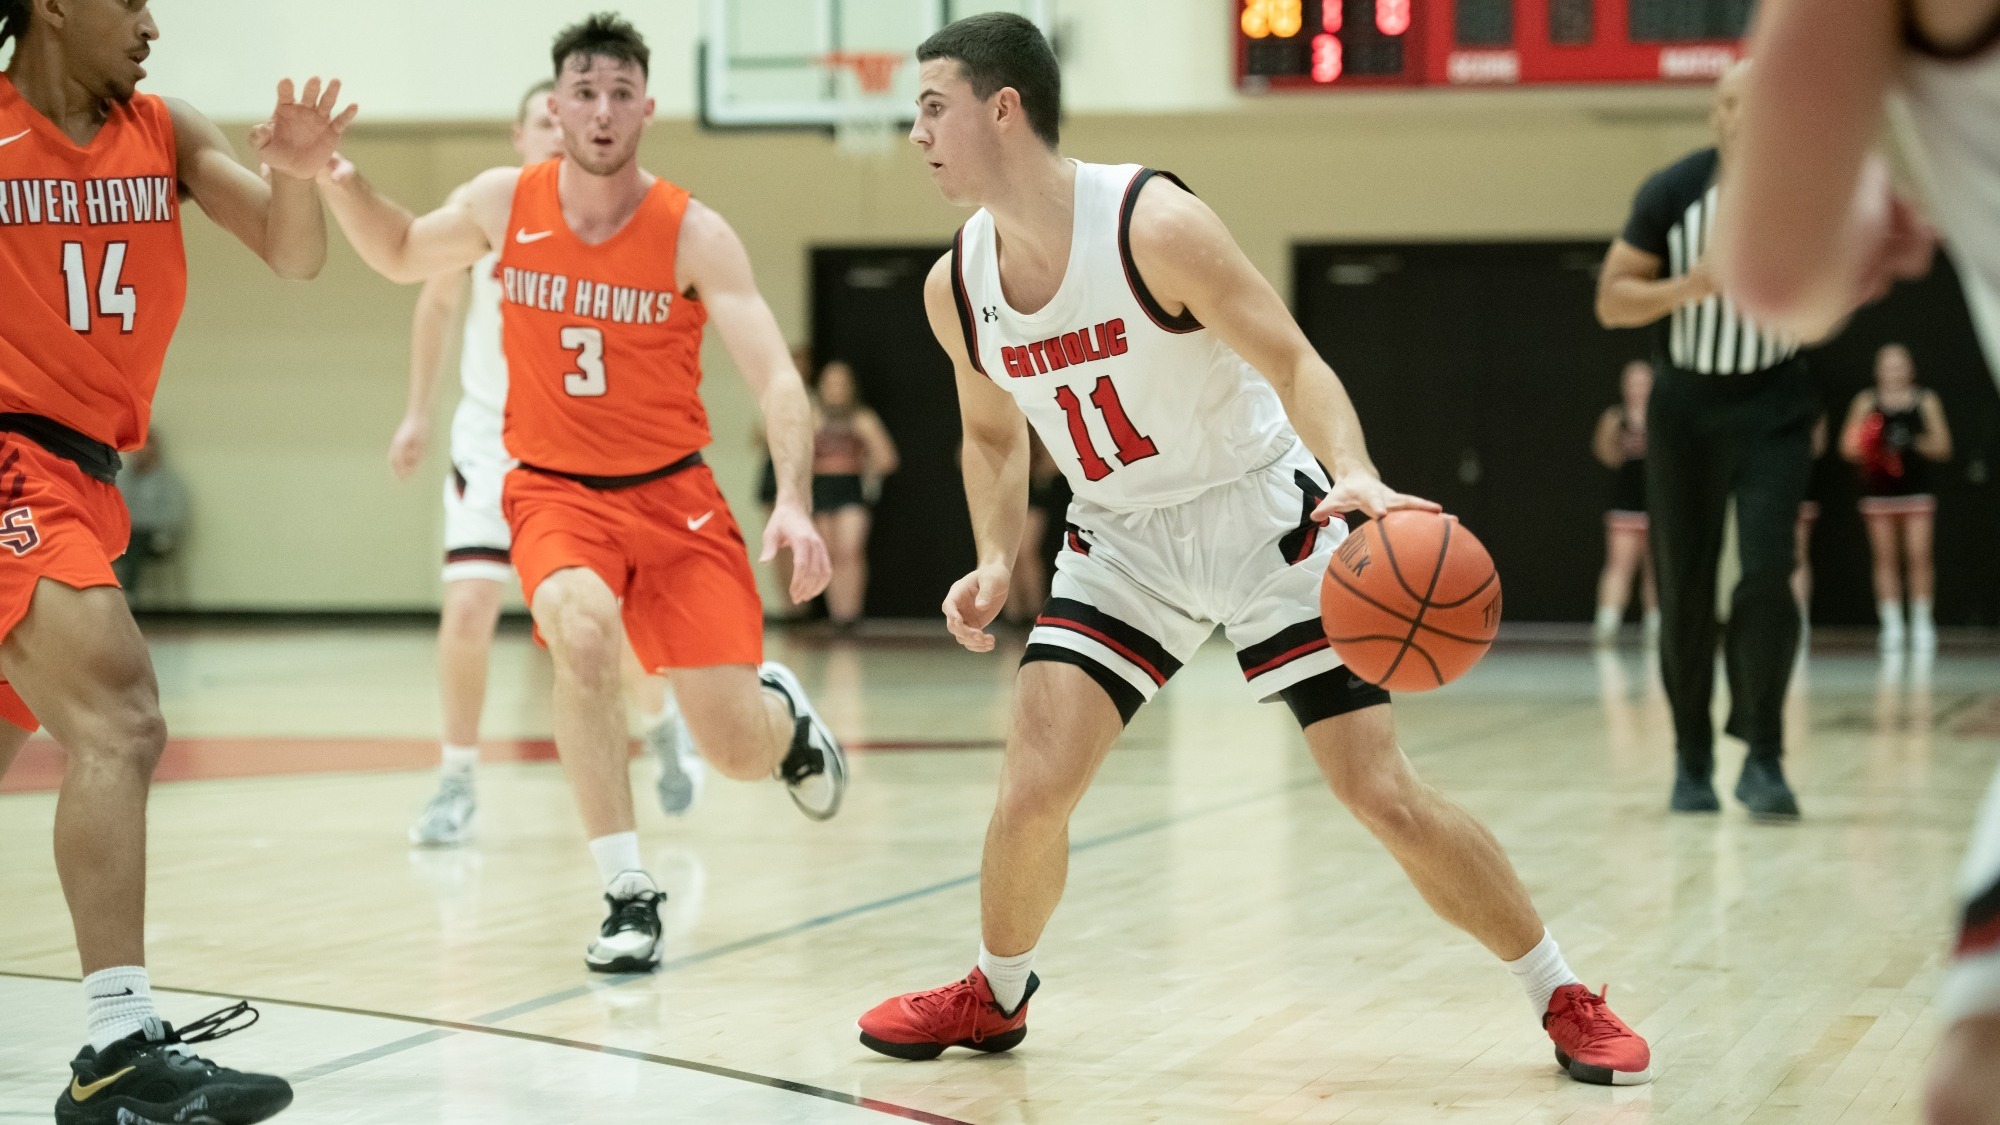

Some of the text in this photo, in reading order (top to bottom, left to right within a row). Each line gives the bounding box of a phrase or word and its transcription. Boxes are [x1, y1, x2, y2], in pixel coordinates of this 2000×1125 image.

[60, 239, 137, 335] 14
[503, 265, 674, 325] RIVER HAWKS
[560, 325, 608, 398] 3
[1000, 317, 1129, 379] CATHOLIC
[1053, 374, 1160, 482] 11
